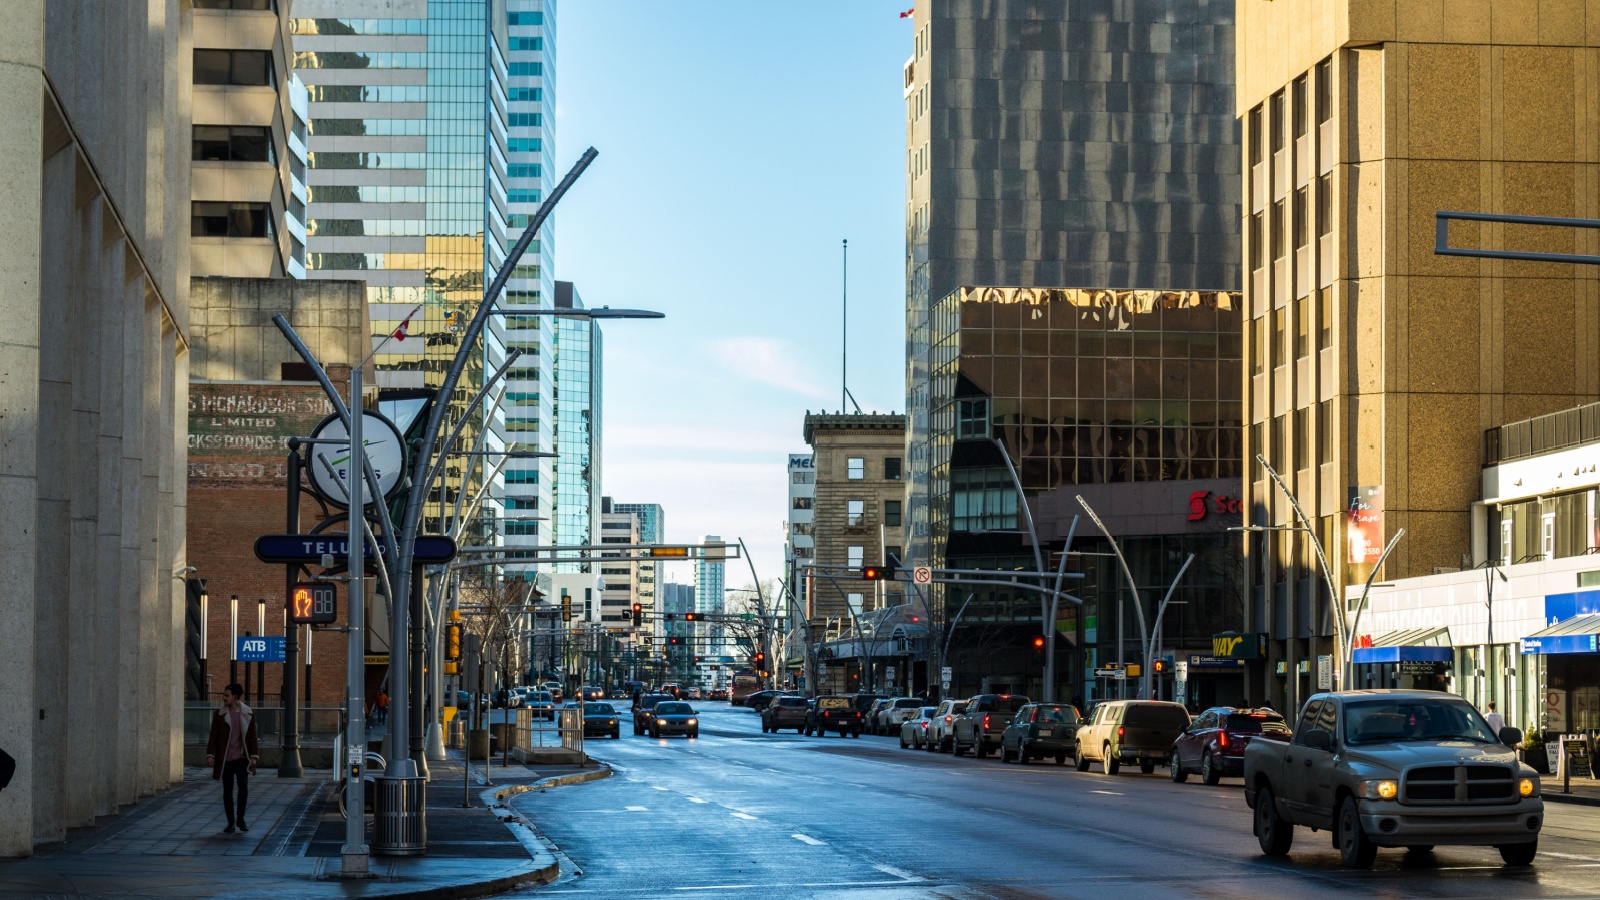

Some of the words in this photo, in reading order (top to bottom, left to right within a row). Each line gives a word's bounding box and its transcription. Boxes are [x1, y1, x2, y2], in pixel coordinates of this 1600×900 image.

[211, 417, 276, 427] LIMITED
[1350, 496, 1371, 511] For
[242, 640, 266, 652] ATB
